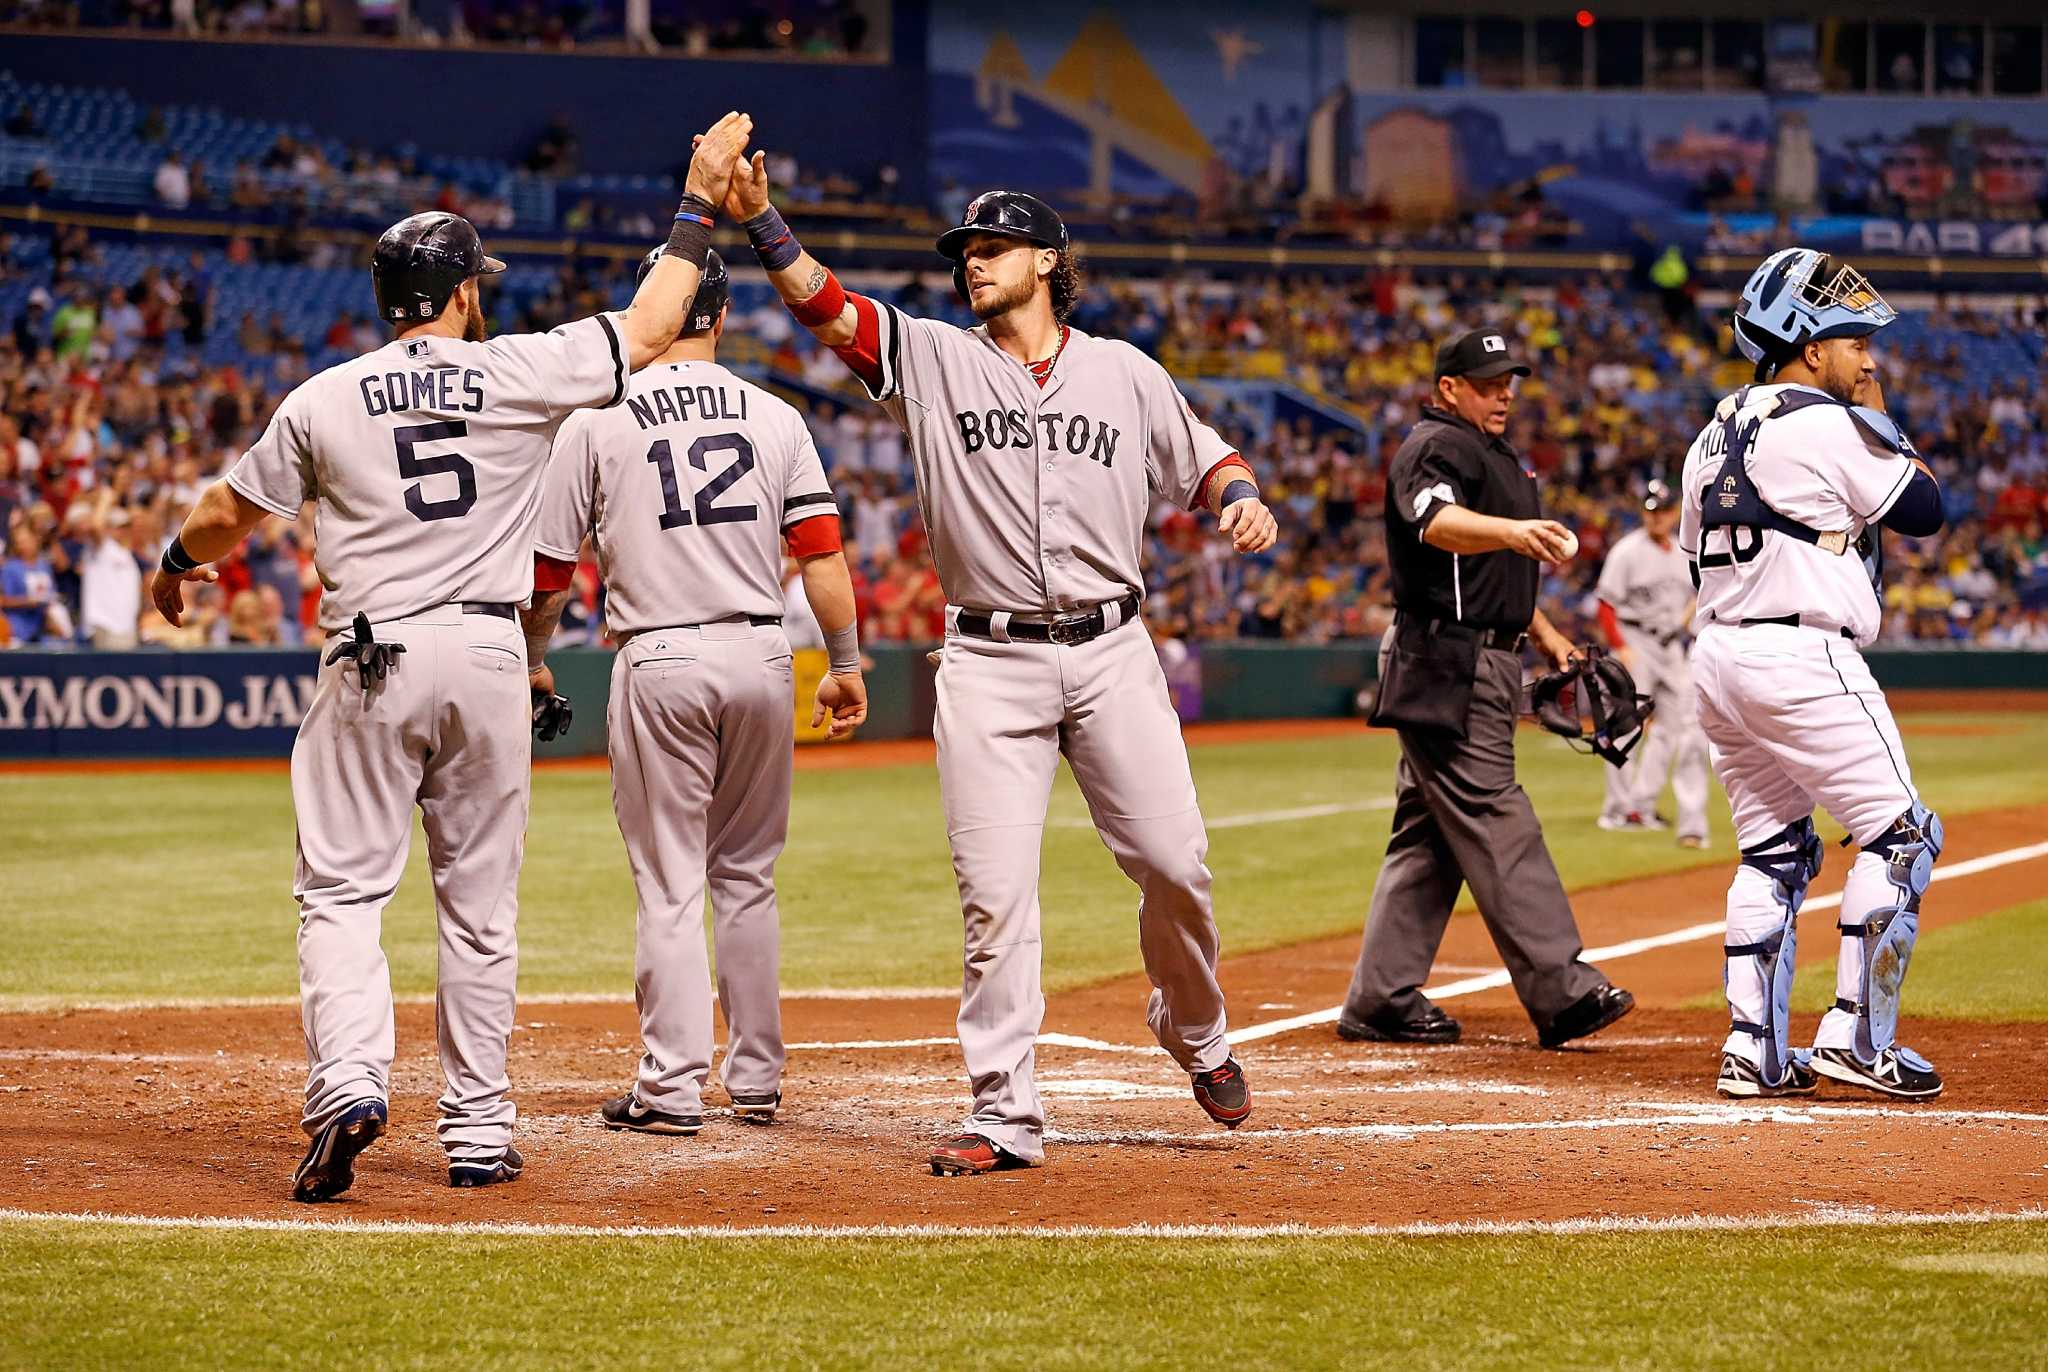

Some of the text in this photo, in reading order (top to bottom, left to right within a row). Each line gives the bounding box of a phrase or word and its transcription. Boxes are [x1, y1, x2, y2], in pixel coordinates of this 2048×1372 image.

[420, 301, 433, 317] 5
[695, 315, 711, 330] 12
[360, 368, 485, 417] GOMES
[626, 385, 747, 430] NAPOLI
[956, 409, 1121, 468] BOSTON
[393, 419, 478, 522] 5
[646, 432, 758, 531] 12
[0, 675, 222, 729] YMOND
